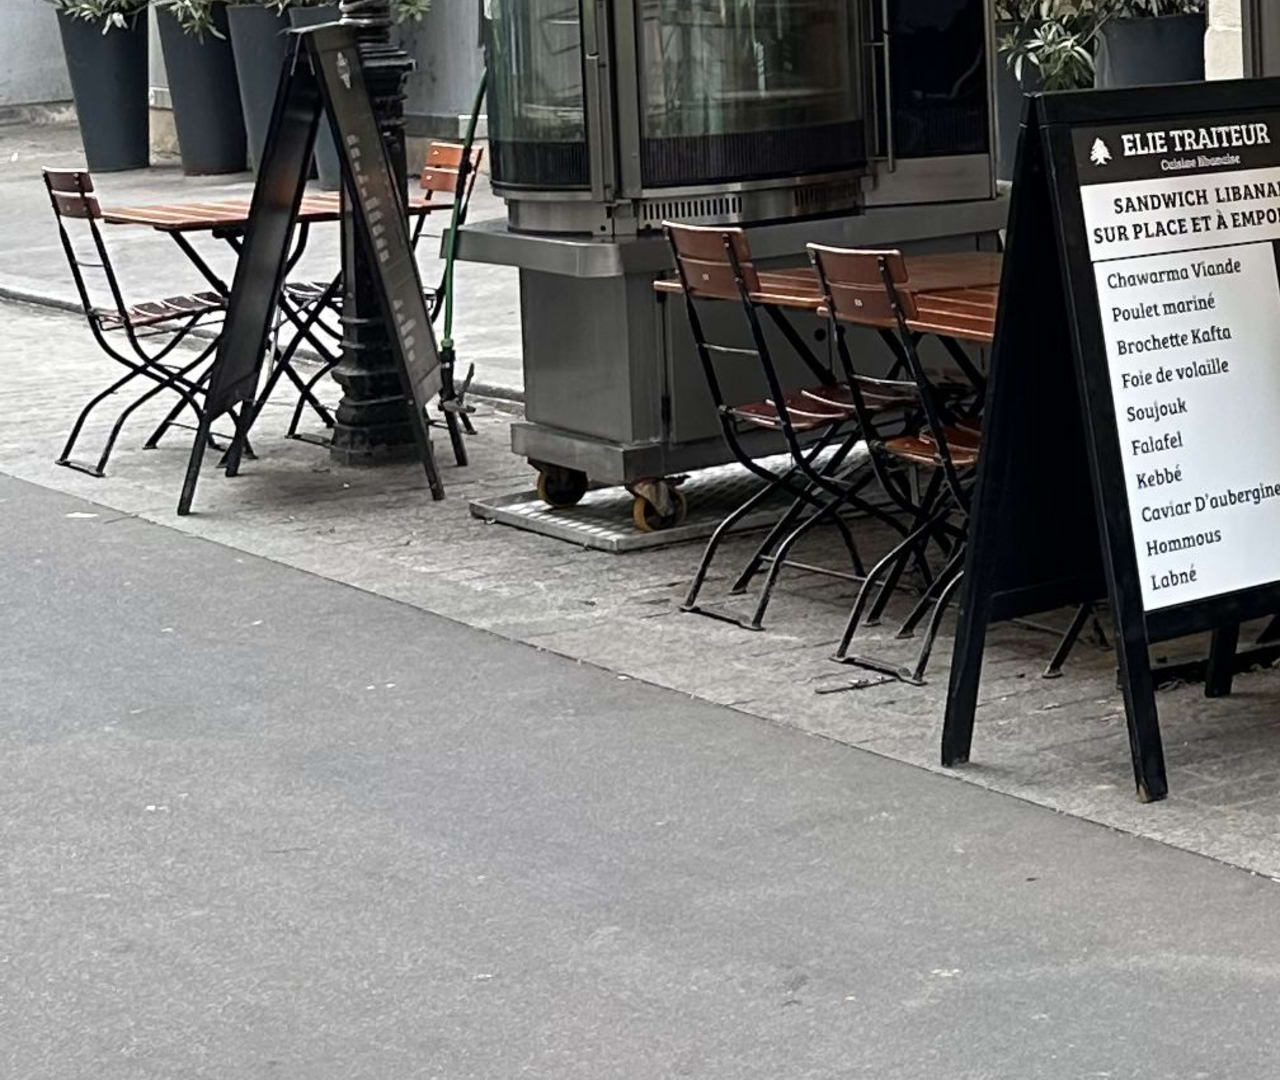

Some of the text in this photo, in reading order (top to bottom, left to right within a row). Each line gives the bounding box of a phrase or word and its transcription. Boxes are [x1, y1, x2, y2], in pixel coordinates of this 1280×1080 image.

[1121, 123, 1271, 157] ELIE TRAITEUR
[1114, 189, 1208, 214] SANDWICH
[1094, 225, 1129, 244] SUR
[1133, 218, 1188, 240] PLACE
[1192, 216, 1211, 233] ET
[1216, 209, 1228, 230] À
[1107, 268, 1188, 289] Chawarma
[1191, 258, 1241, 279] Viande
[1111, 303, 1161, 322] Poulet
[1163, 292, 1216, 316] mariné
[1117, 332, 1188, 356] Brochette
[1191, 325, 1232, 345] Kafta
[1121, 370, 1152, 389] Foie
[1156, 366, 1173, 384] de
[1175, 357, 1230, 380] volaille
[1126, 398, 1188, 422] Soujouk
[1131, 431, 1184, 456] Falafel
[1136, 464, 1183, 490] Kebbé
[1141, 500, 1192, 522] Caviar
[1146, 529, 1222, 557] Hommous
[1150, 564, 1197, 591] Labné
